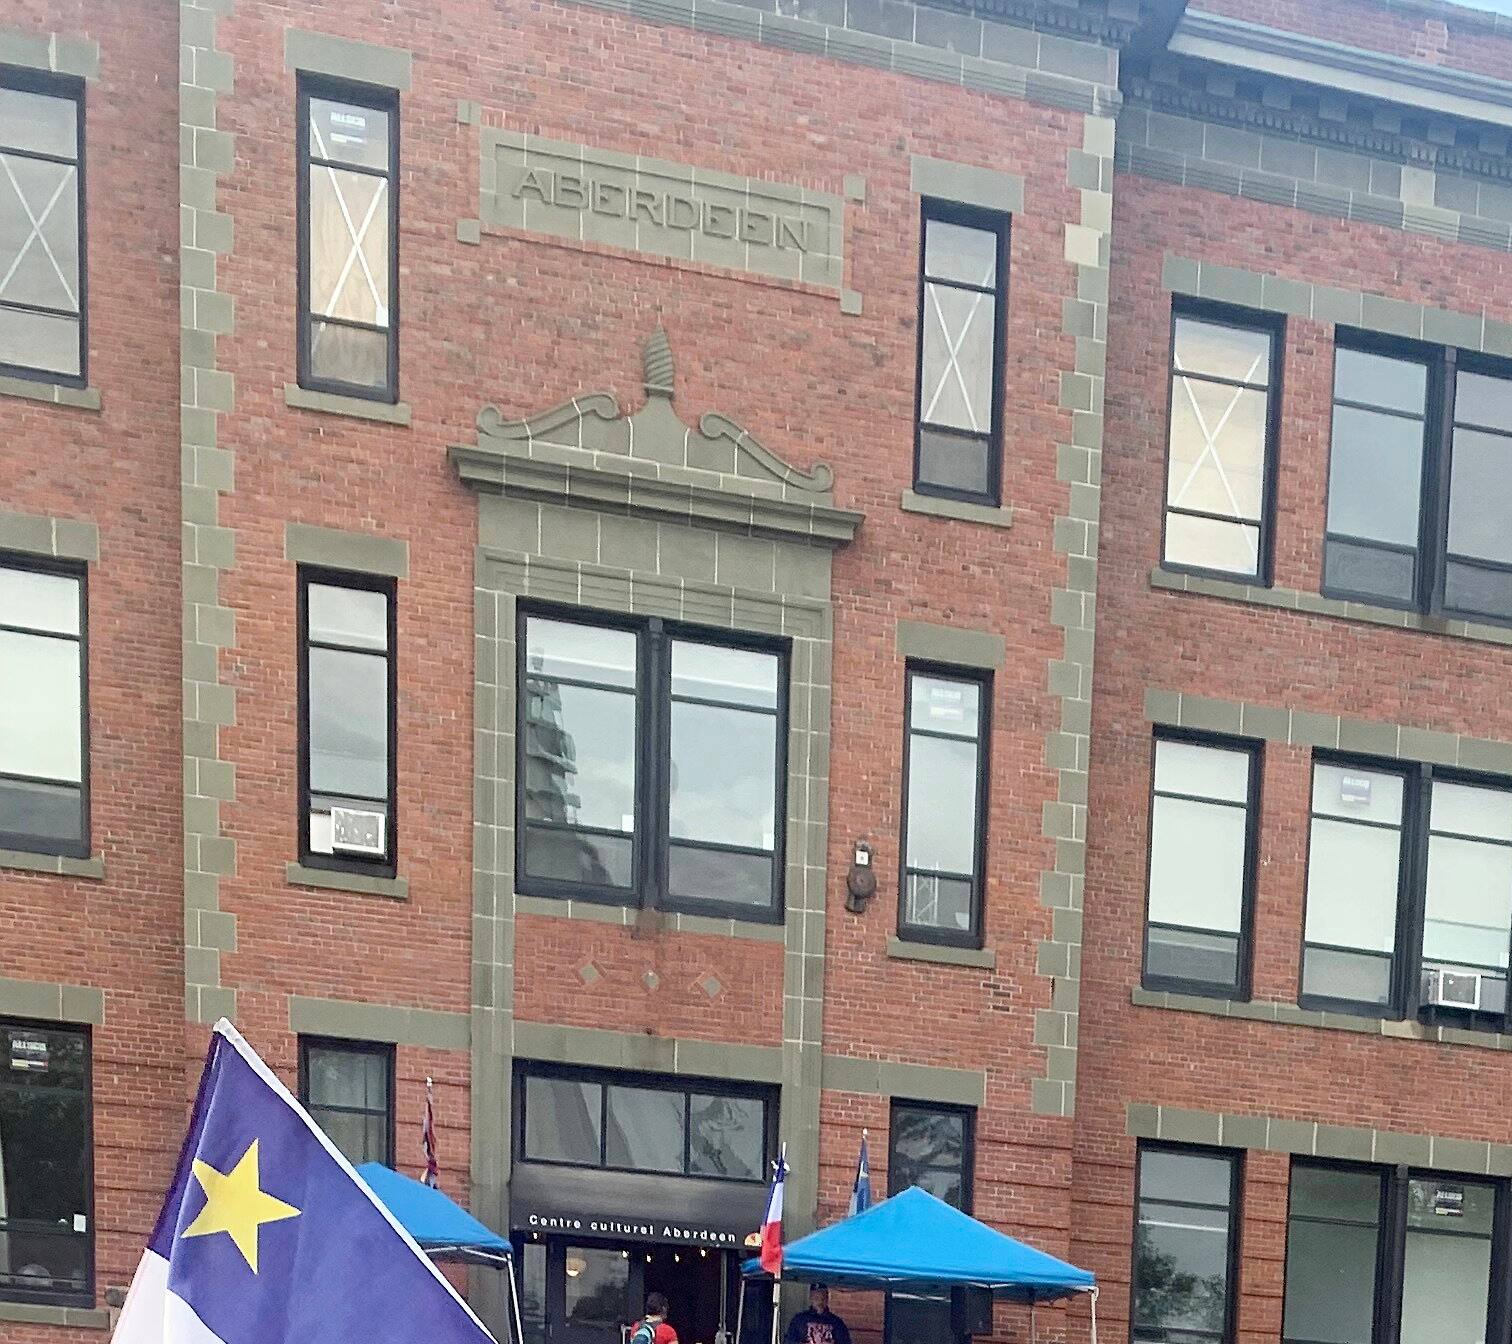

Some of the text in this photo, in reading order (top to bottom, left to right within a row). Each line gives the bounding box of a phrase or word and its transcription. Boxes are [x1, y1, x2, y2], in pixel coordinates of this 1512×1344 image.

[511, 171, 811, 253] ABERDEEN
[529, 1214, 737, 1243] Centre culturel Aberdeen
